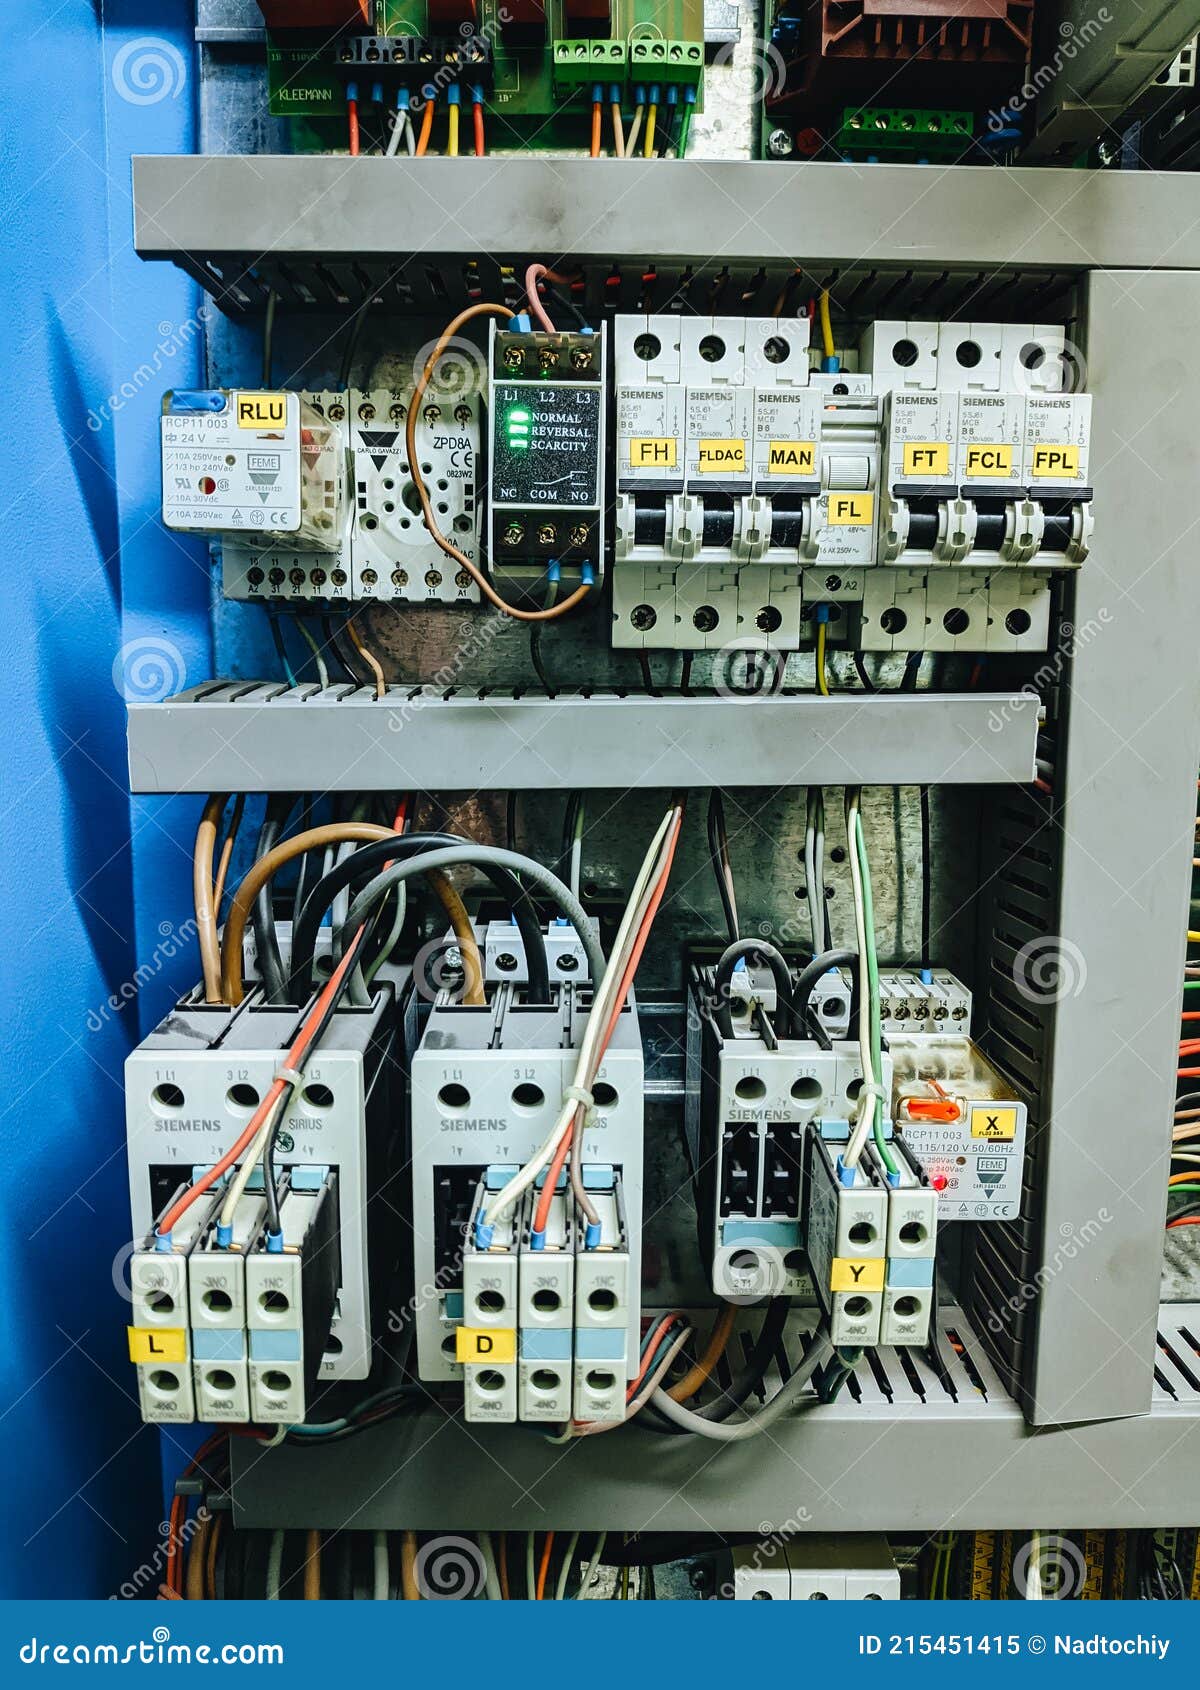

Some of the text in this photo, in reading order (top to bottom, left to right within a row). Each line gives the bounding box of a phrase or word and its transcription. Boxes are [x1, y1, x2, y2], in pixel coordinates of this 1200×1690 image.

[279, 88, 332, 101] KLEEMANN
[854, 383, 866, 394] A1
[334, 396, 343, 404] 12
[504, 390, 591, 404] L1 L2 L3
[620, 391, 664, 400] SIEMENS
[690, 392, 733, 401] SIEMENS
[758, 394, 801, 403] SIEMENS
[895, 396, 939, 405] SIEMENS
[962, 398, 1005, 407] SIEMENS
[1029, 399, 1071, 409] SIEMENS
[240, 402, 284, 420] RLU
[532, 412, 582, 423] NORMAL
[165, 418, 229, 429] RCP11 003
[531, 426, 591, 438] REVERSAL
[181, 433, 206, 443] 24 V
[433, 436, 472, 450] ZPD8A
[530, 440, 589, 452] SCARCITY
[175, 453, 190, 461] 10A
[640, 443, 669, 461] FH
[699, 449, 743, 462] FLDAC
[770, 449, 812, 465] MAN
[251, 458, 277, 468] FEME
[912, 450, 938, 467] FT
[968, 451, 1007, 469] FCL
[1035, 452, 1073, 469] FPL
[501, 488, 589, 501] NC COM NO
[837, 501, 861, 517] FL
[175, 511, 191, 519] 10A
[248, 584, 259, 593] A2
[271, 585, 281, 593] 31
[292, 585, 301, 594] 21
[333, 587, 343, 595] A1
[362, 586, 372, 594] A2
[457, 589, 467, 597] A1
[843, 581, 858, 591] A2
[486, 945, 585, 955] A1 A2
[165, 1071, 176, 1081] L1
[238, 1071, 249, 1081] L2
[310, 1070, 321, 1080] L3
[453, 1070, 463, 1080] L1
[525, 1068, 536, 1080] L2
[728, 1110, 792, 1120] SIEMENS
[154, 1119, 221, 1132] SIEMENS
[288, 1118, 322, 1130] SIRIUS
[440, 1119, 507, 1132] SIEMENS
[986, 1116, 999, 1131] X
[905, 1130, 962, 1140] RCP11 003
[919, 1143, 959, 1152] 115/120
[972, 1144, 1014, 1153] 50/60Hz
[980, 1160, 1003, 1169] FEME
[849, 1265, 866, 1282] Y
[148, 1334, 164, 1354] L
[476, 1335, 493, 1354] D
